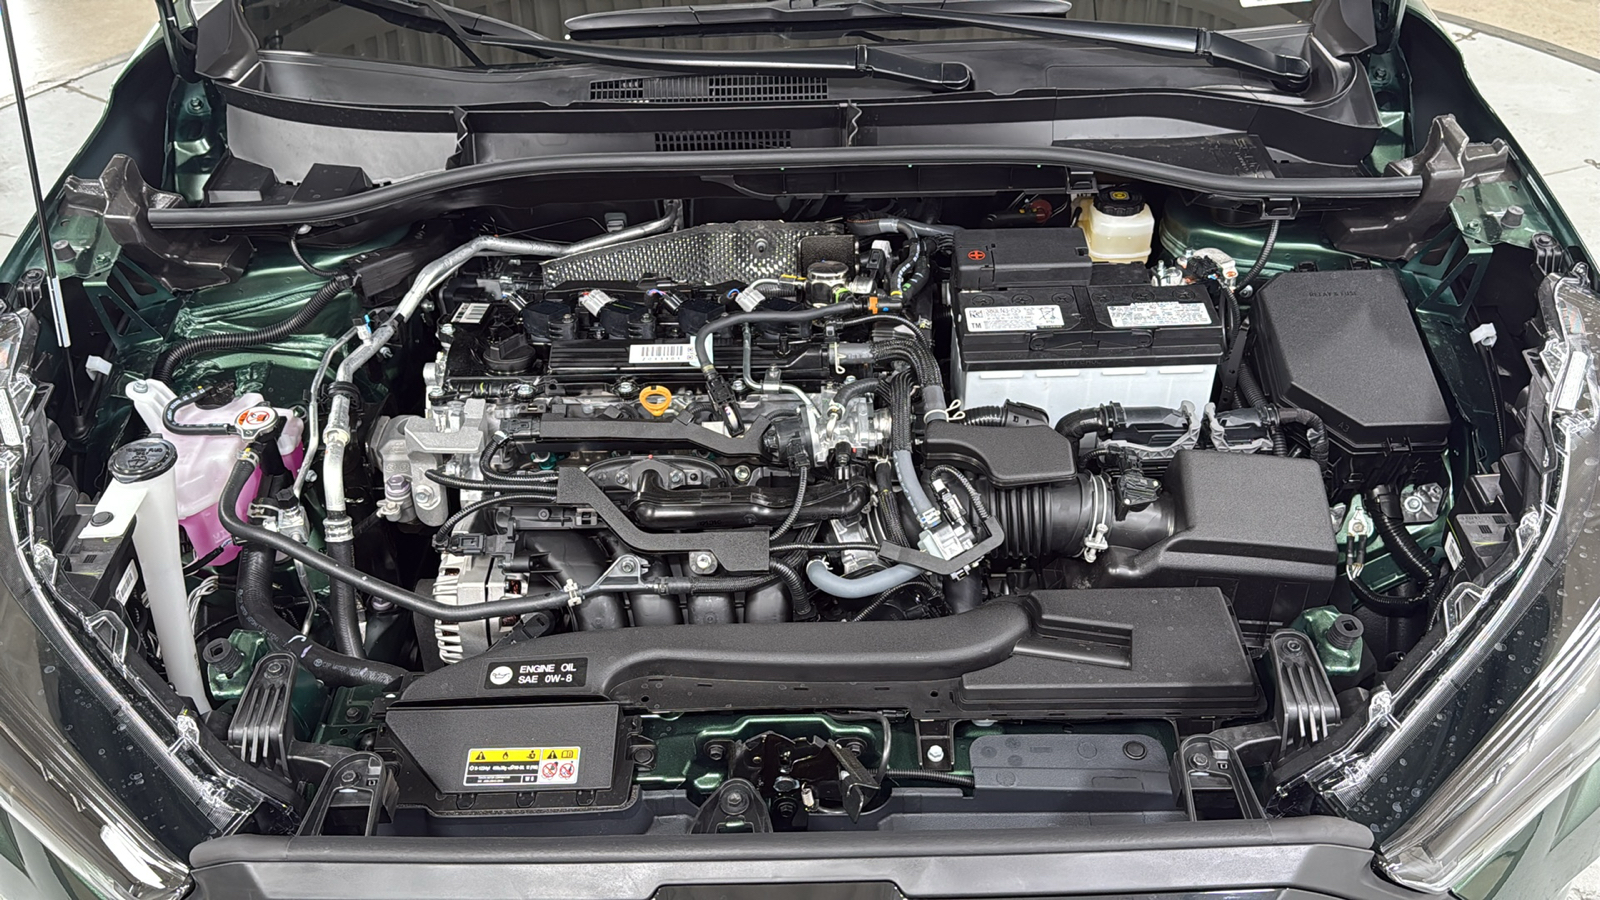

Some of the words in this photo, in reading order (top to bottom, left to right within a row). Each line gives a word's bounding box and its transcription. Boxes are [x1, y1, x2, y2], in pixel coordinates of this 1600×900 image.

[520, 664, 555, 674] ENGINE
[560, 663, 577, 672] OIL
[518, 675, 538, 684] SAE
[545, 674, 573, 683] 0W-8
